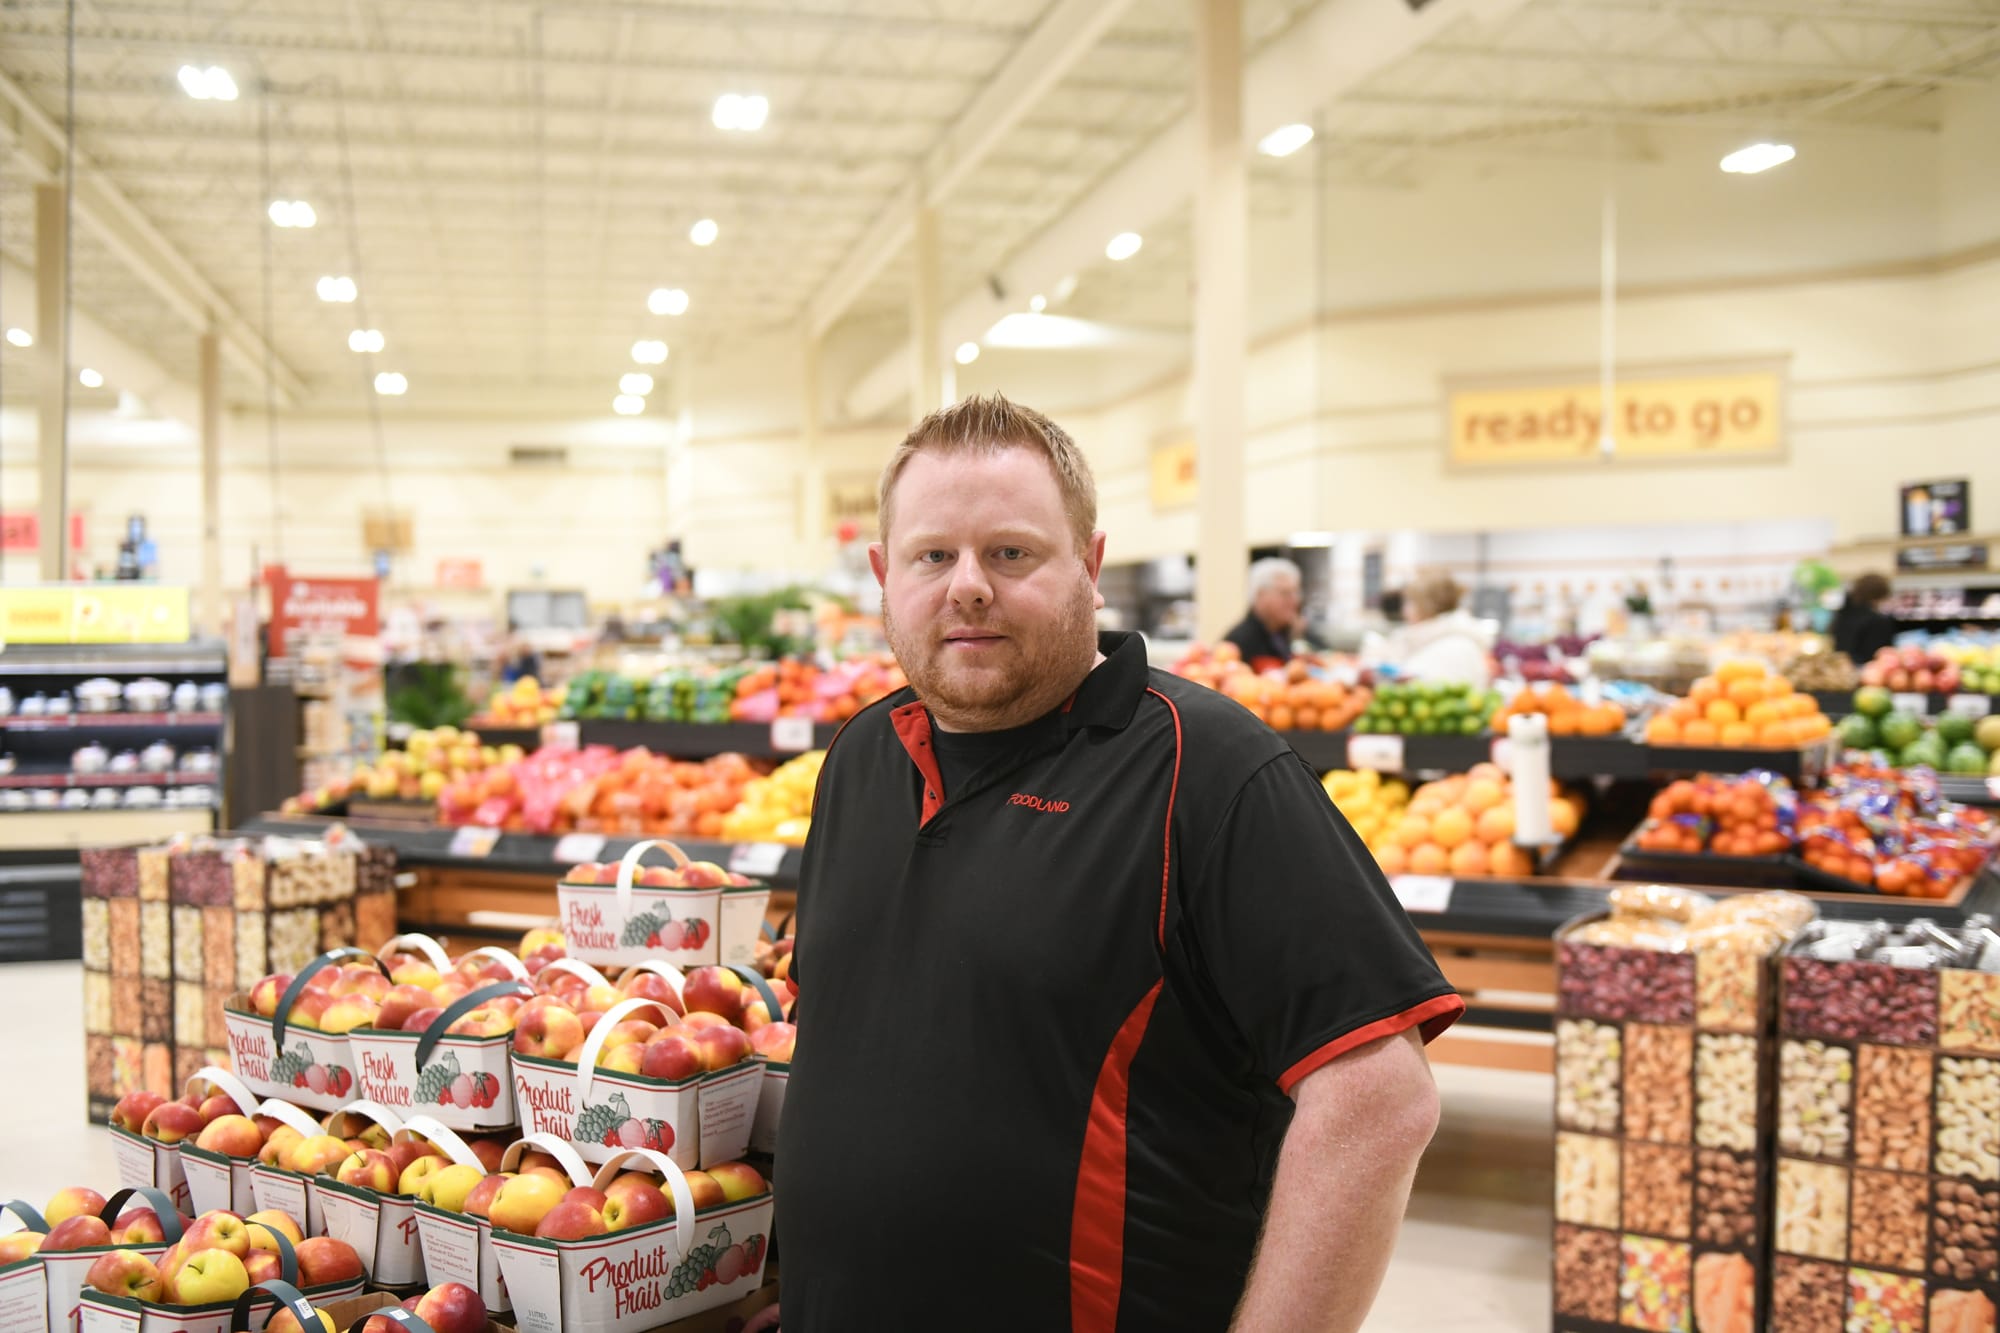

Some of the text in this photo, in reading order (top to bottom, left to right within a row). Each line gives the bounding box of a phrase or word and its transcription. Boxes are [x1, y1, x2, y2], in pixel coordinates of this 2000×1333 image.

[1464, 395, 1762, 454] ready to go
[1006, 793, 1070, 812] FOODLAND
[569, 901, 605, 930] Fresh
[237, 1051, 270, 1082] Frais
[362, 1051, 398, 1083] Fresh
[532, 1106, 572, 1142] Frais
[579, 1245, 670, 1293] Produit
[614, 1281, 662, 1320] Frais
